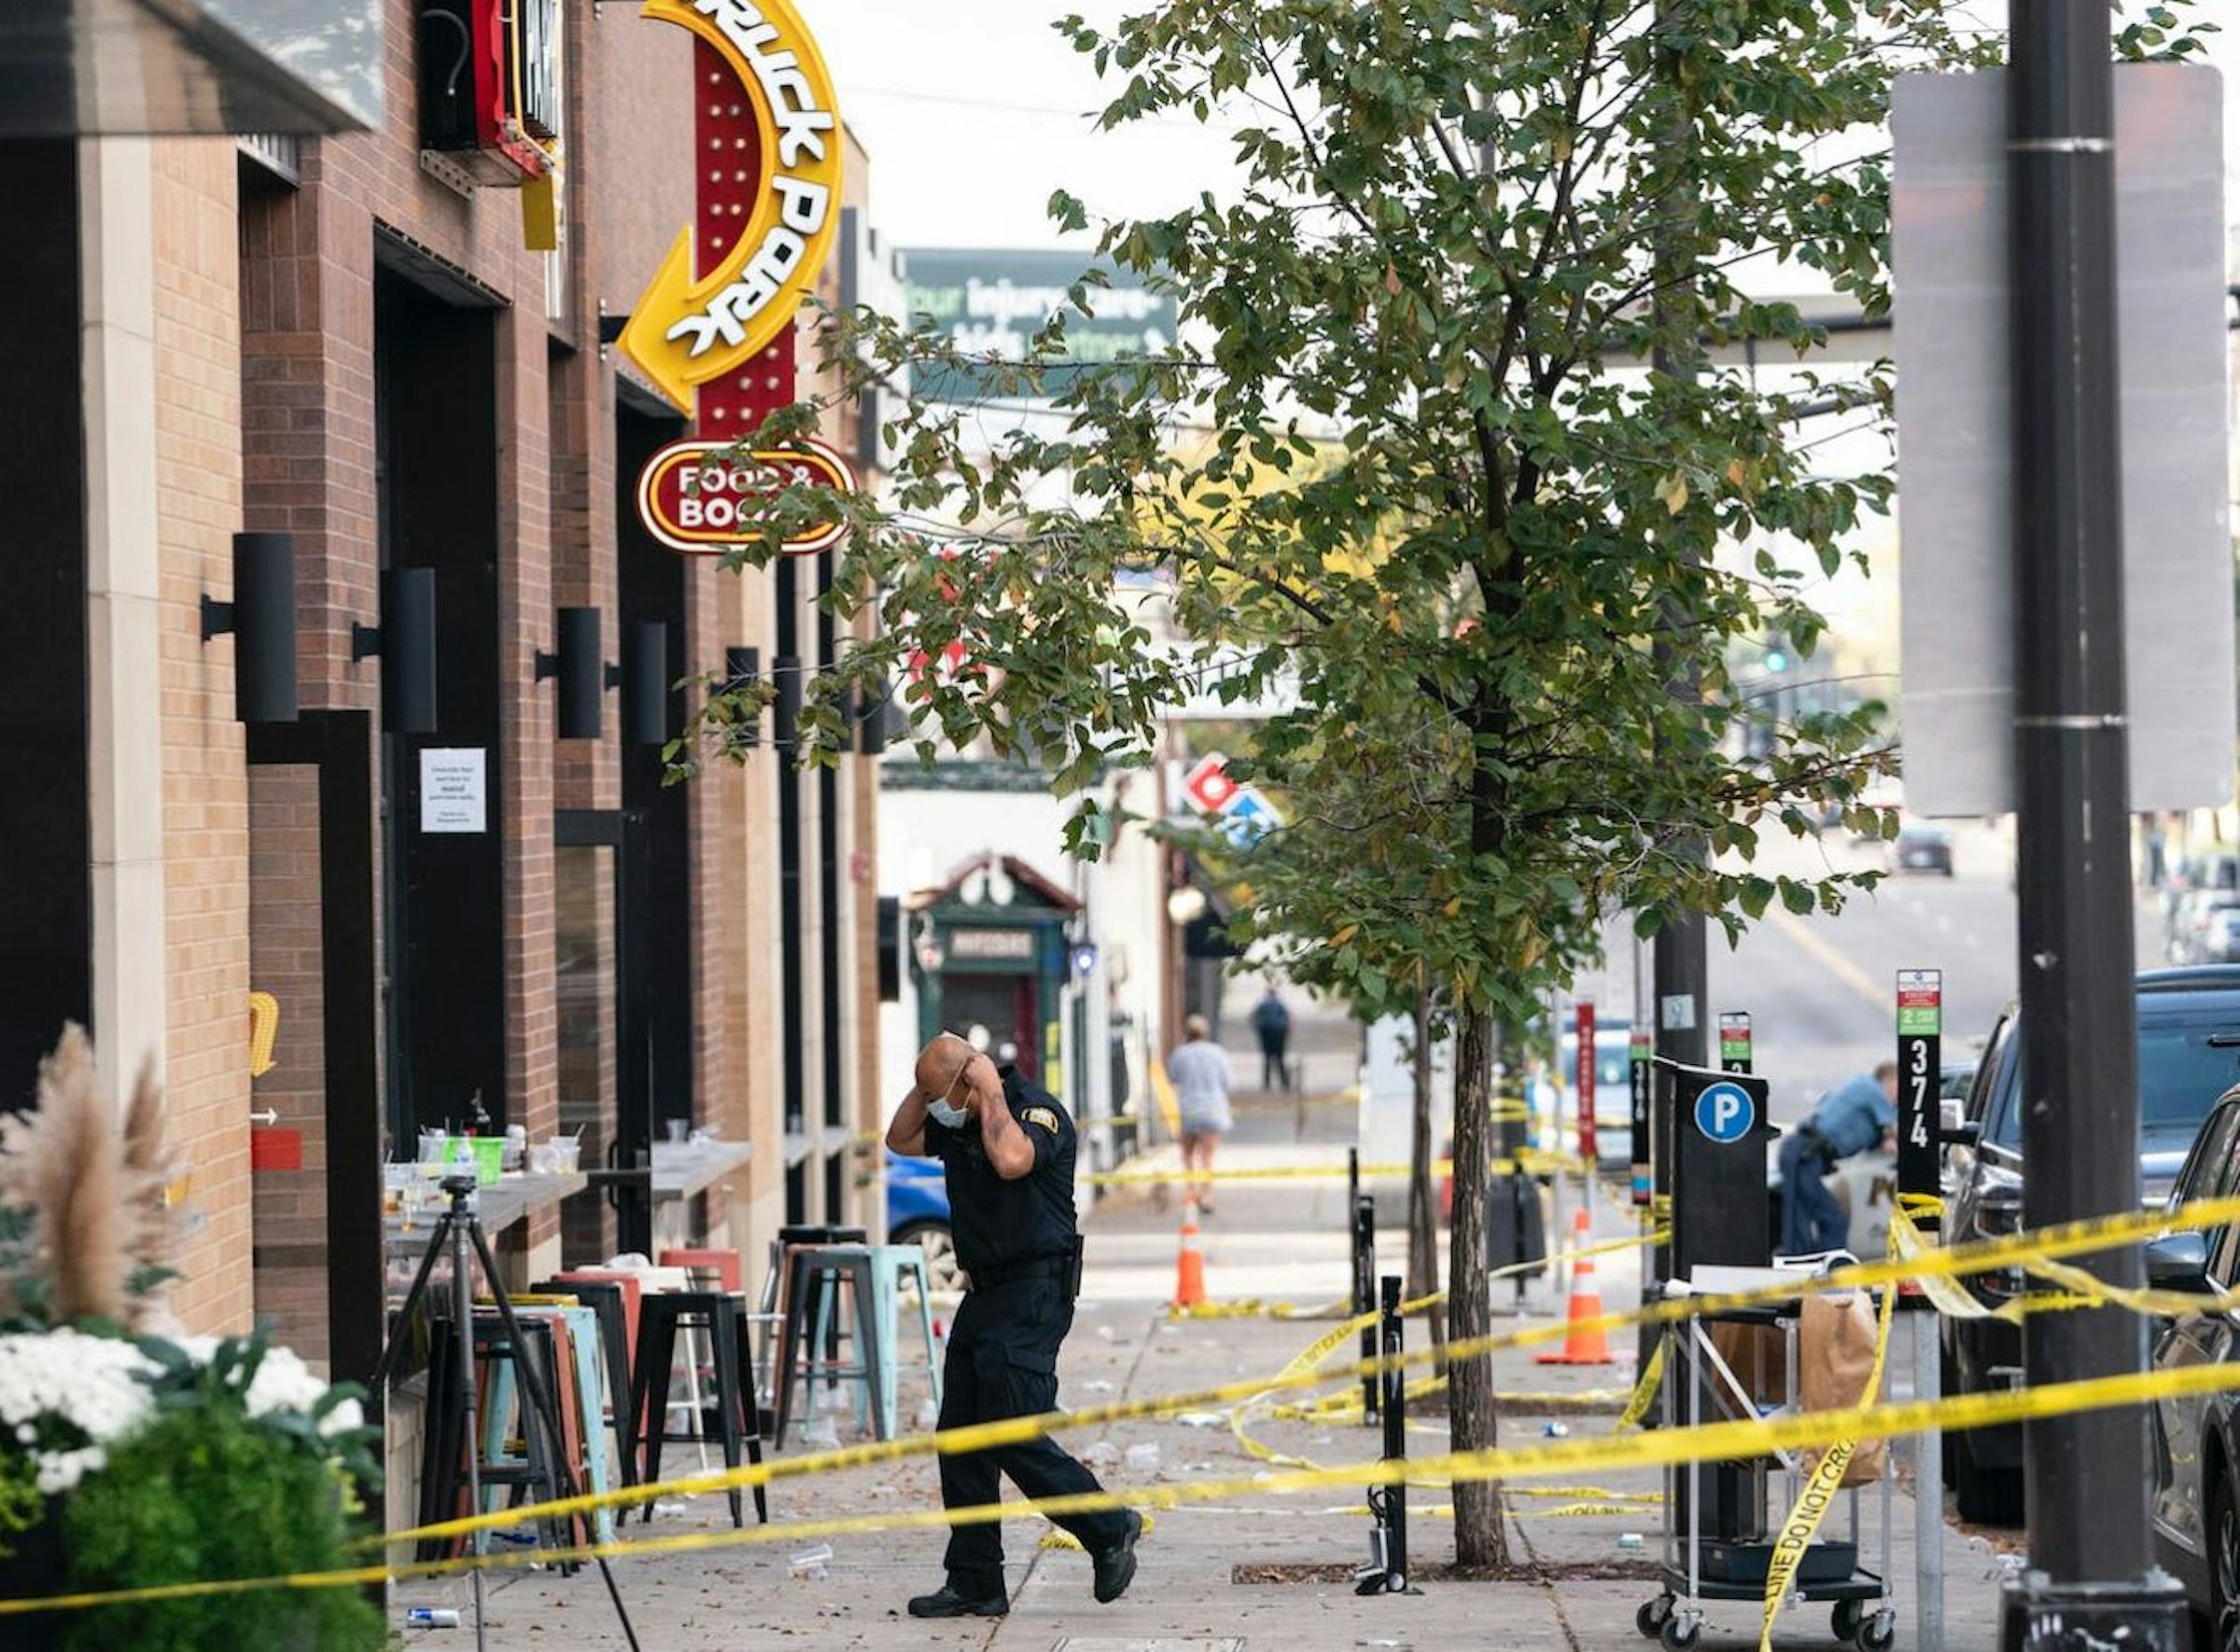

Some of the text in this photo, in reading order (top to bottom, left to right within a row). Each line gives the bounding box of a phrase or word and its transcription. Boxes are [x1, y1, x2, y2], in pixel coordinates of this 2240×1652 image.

[679, 466, 780, 493] FOOD
[1715, 1094, 1740, 1132] P
[1911, 1040, 1928, 1147] 374
[1765, 1553, 1796, 1598] LINE
[1781, 1524, 1811, 1554] DO
[1798, 1479, 1828, 1521] NOT
[1822, 1436, 1855, 1481] CRO
